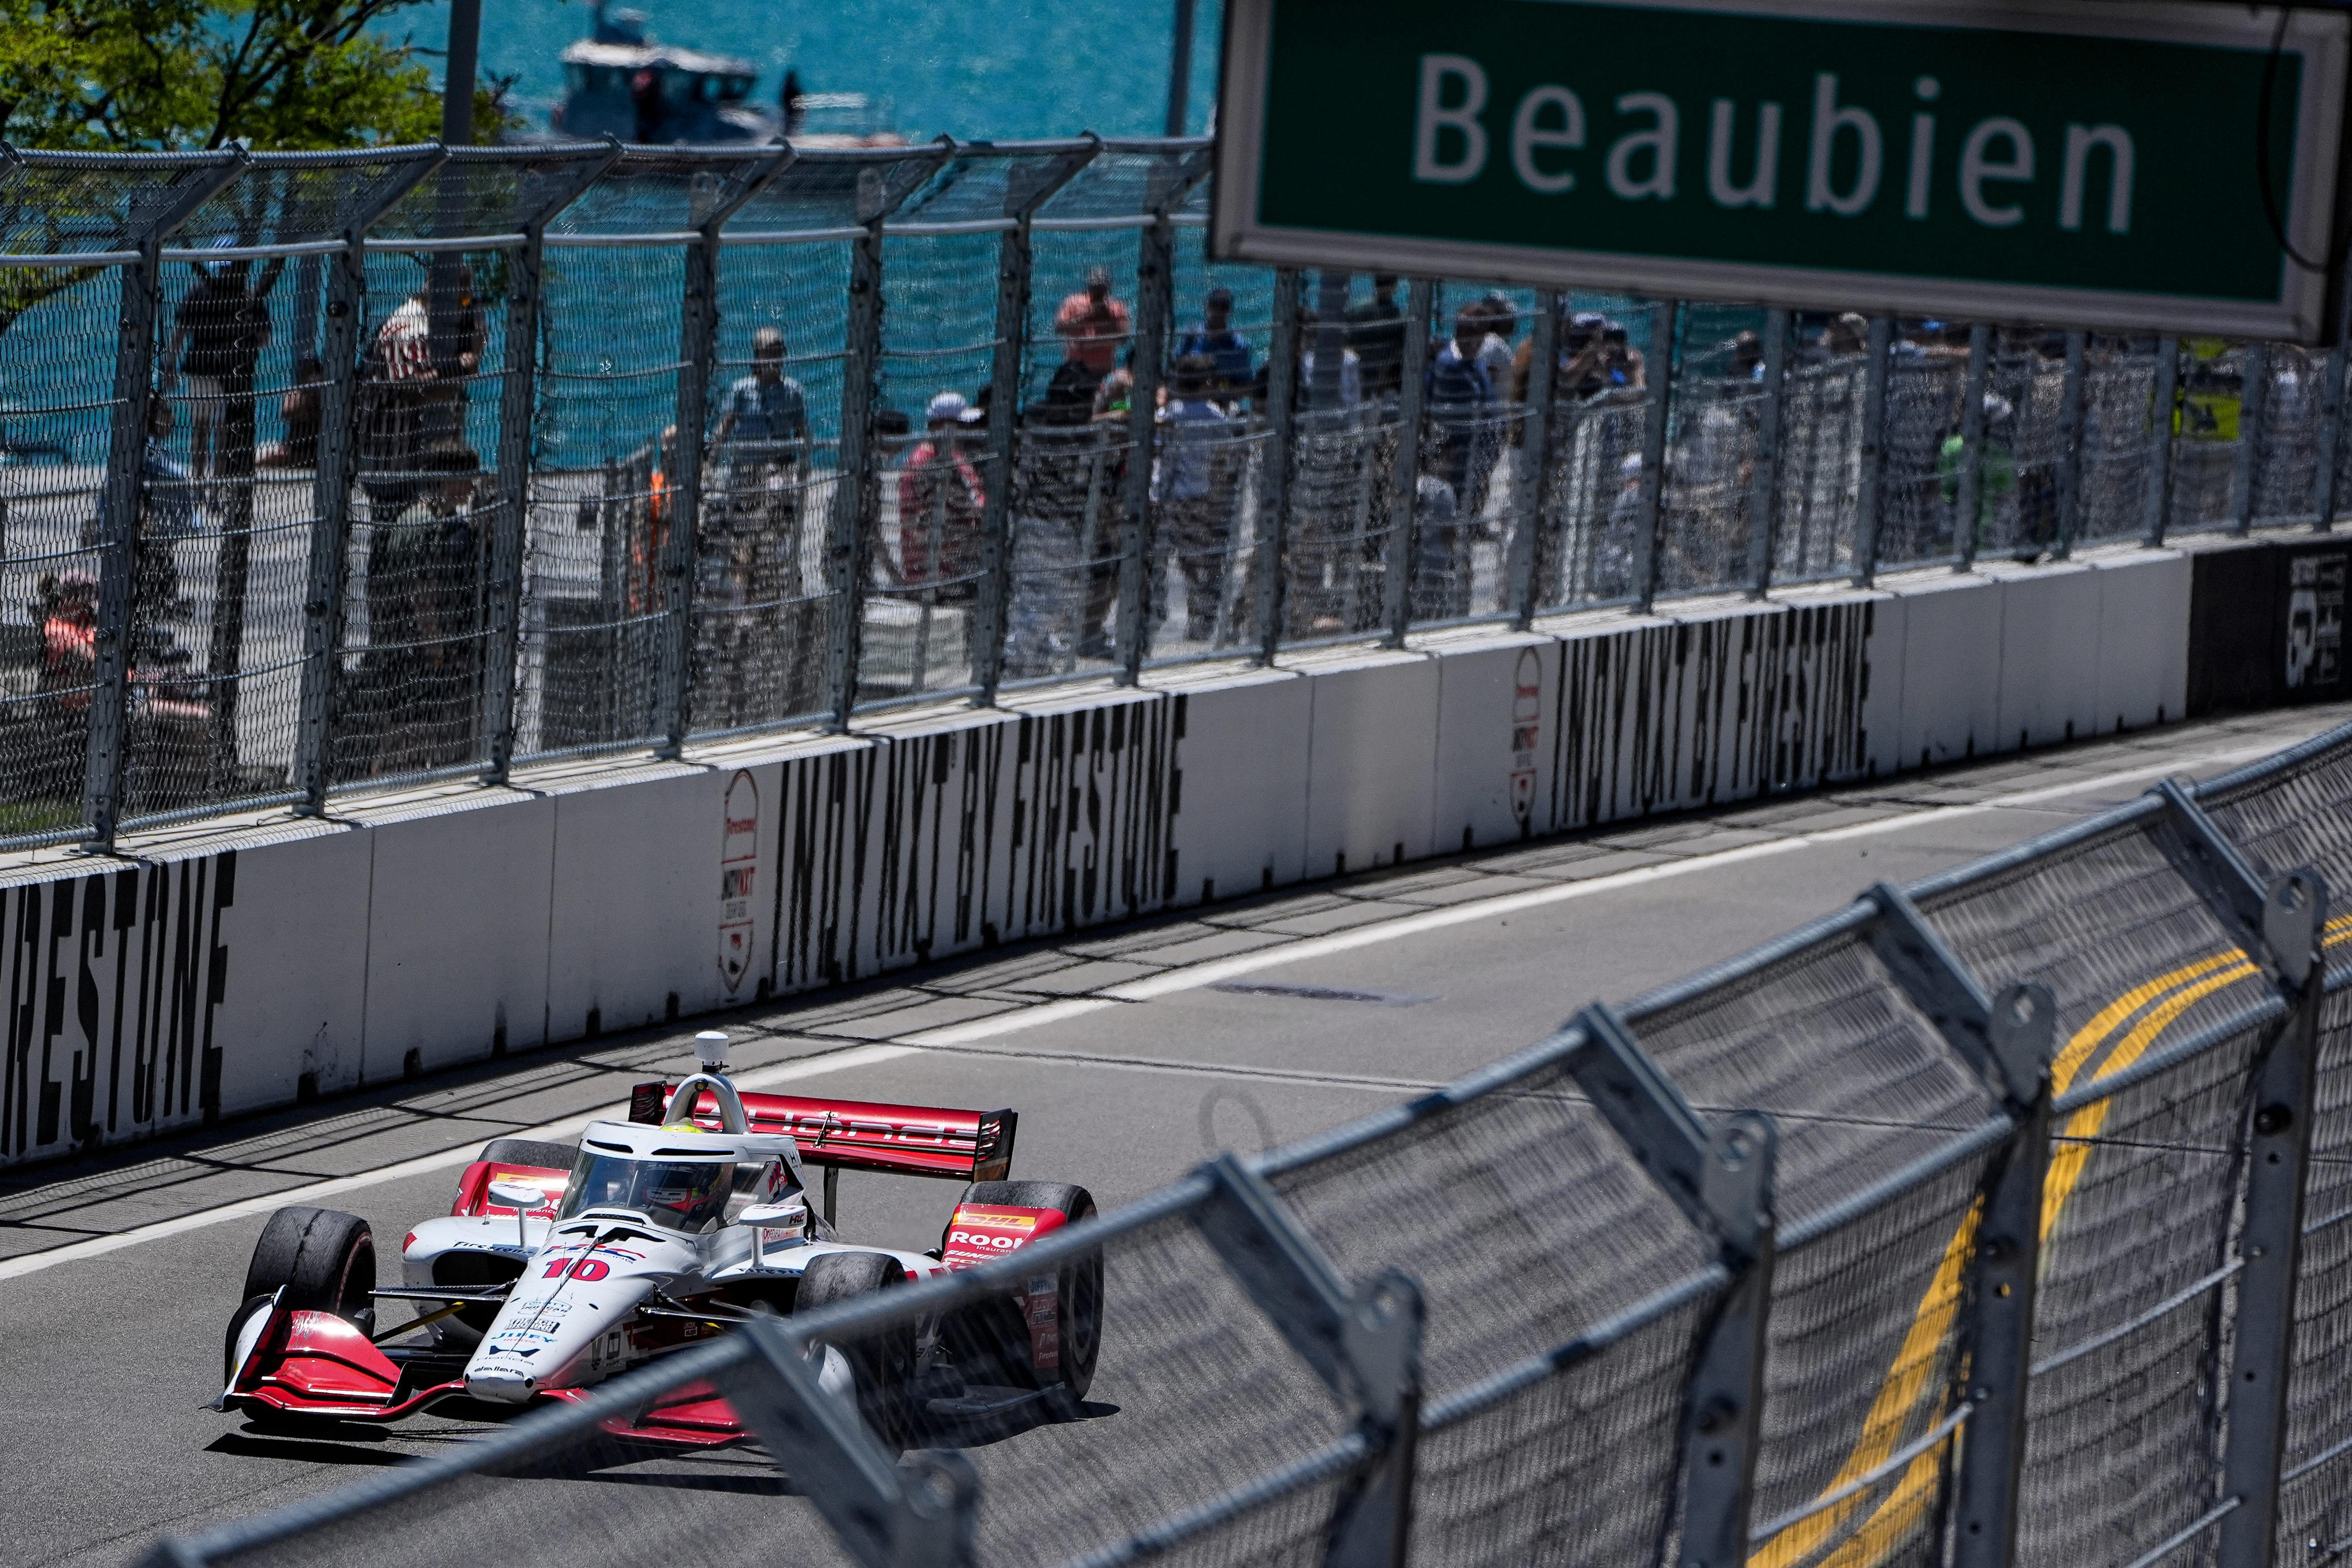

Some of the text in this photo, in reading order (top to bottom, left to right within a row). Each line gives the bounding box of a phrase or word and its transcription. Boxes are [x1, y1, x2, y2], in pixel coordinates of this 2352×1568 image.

[1413, 53, 2134, 233] Beaubien
[1734, 601, 1874, 791] FIRESTONE
[1007, 693, 1188, 929] FIRESTONE
[542, 1258, 610, 1282] 10
[963, 1216, 1023, 1227] DHL
[474, 1366, 525, 1378] dallara
